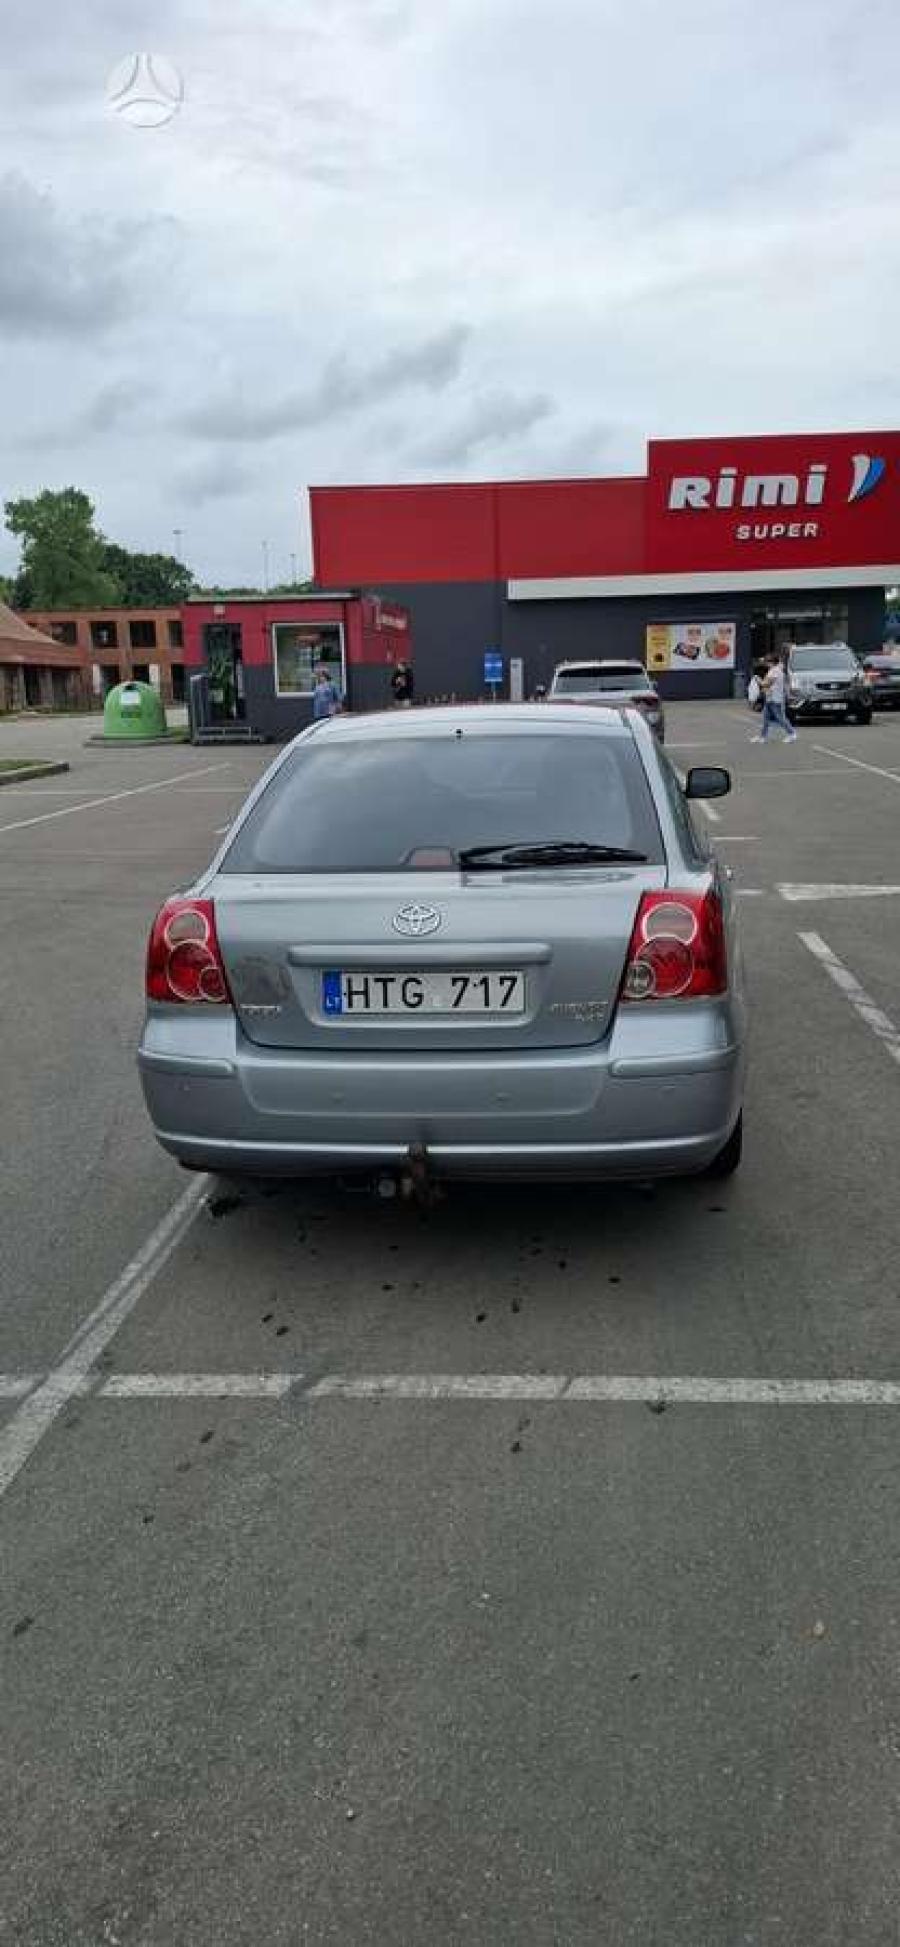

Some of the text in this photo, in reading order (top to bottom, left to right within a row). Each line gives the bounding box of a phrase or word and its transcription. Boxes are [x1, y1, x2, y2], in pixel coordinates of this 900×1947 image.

[736, 523, 819, 540] SUPER
[347, 976, 518, 1009] HTG 717
[326, 996, 340, 1007] LT
